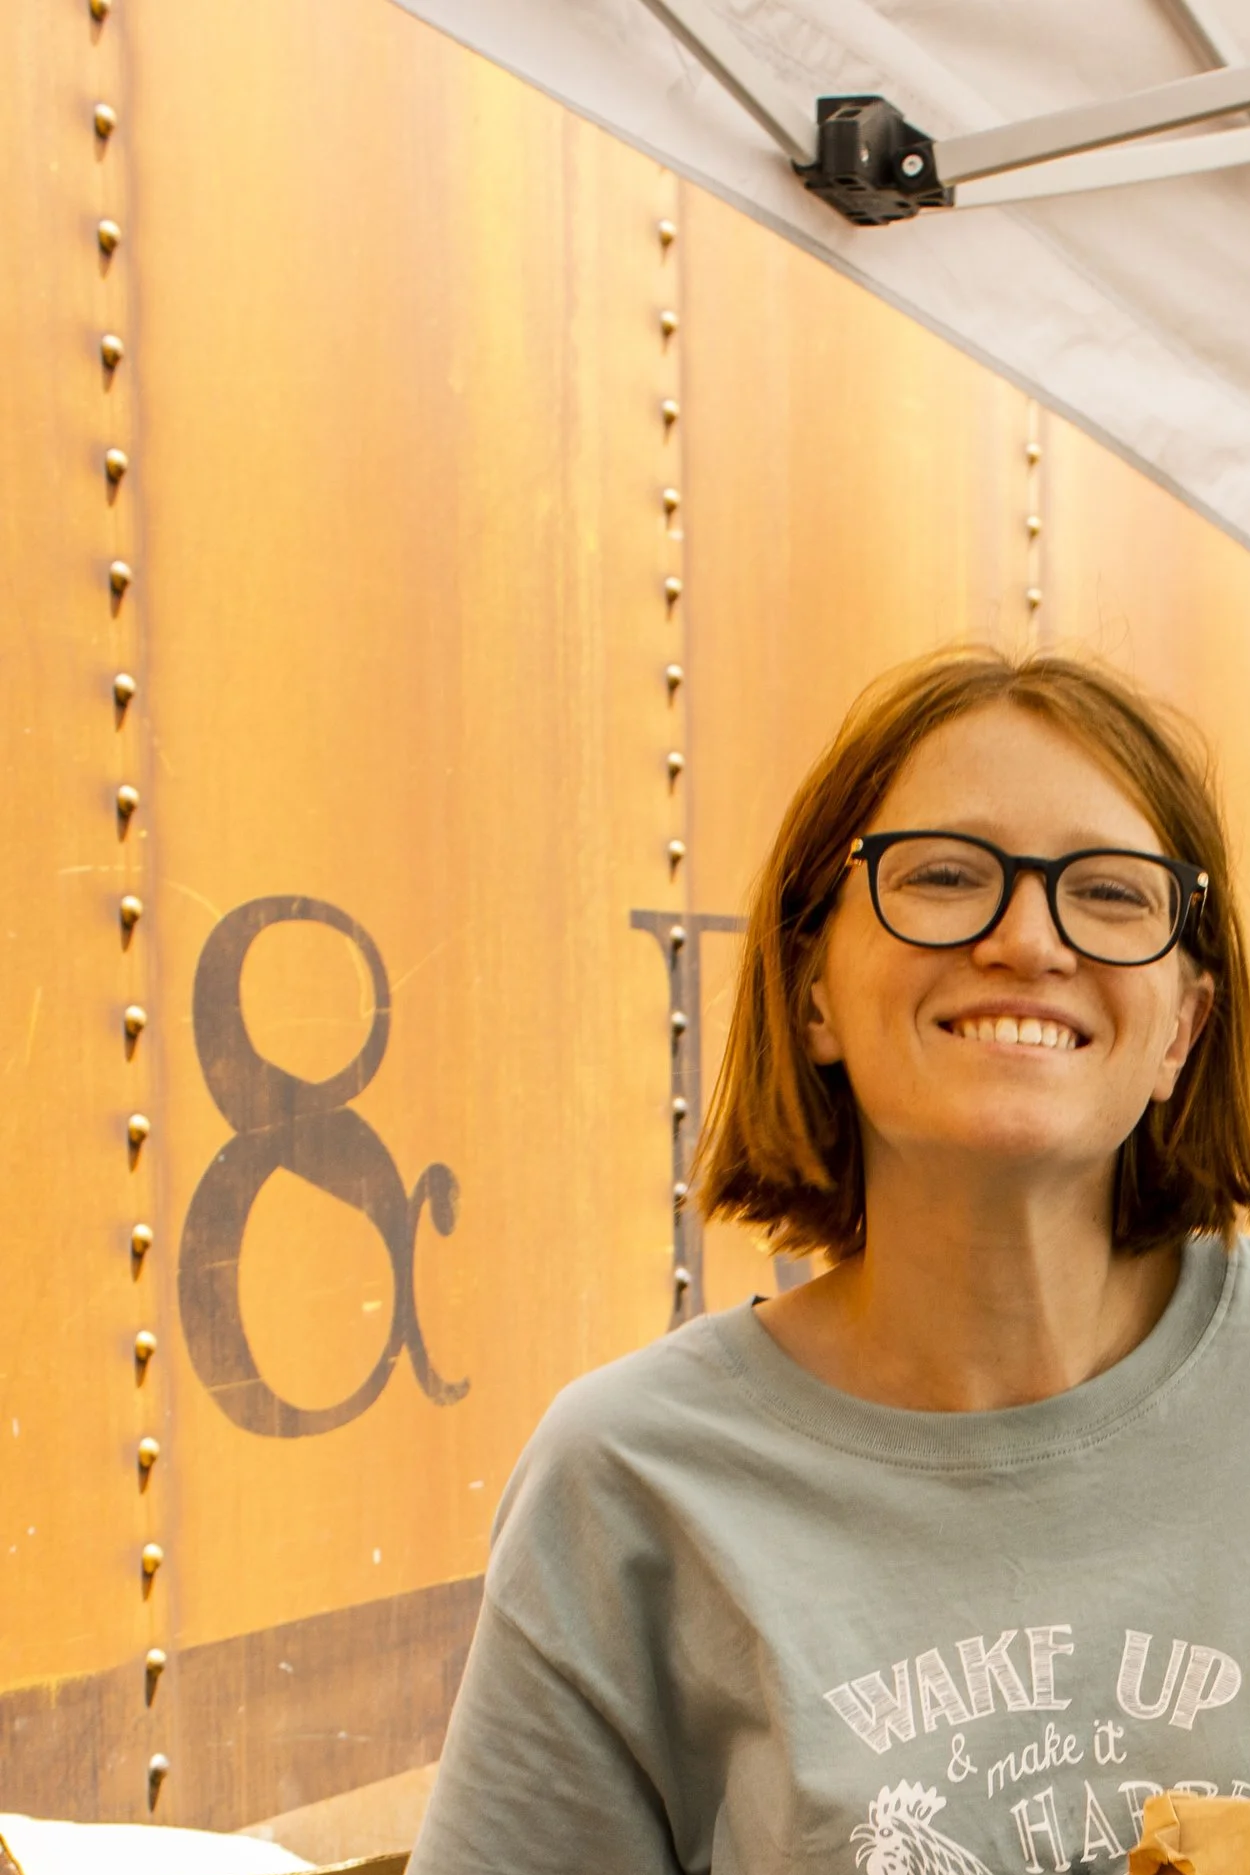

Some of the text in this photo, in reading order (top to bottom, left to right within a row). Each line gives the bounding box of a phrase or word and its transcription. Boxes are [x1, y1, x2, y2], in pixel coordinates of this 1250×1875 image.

[178, 894, 471, 1439] &
[823, 1624, 1242, 1755] WAKE UP
[946, 1719, 1127, 1799] & make it
